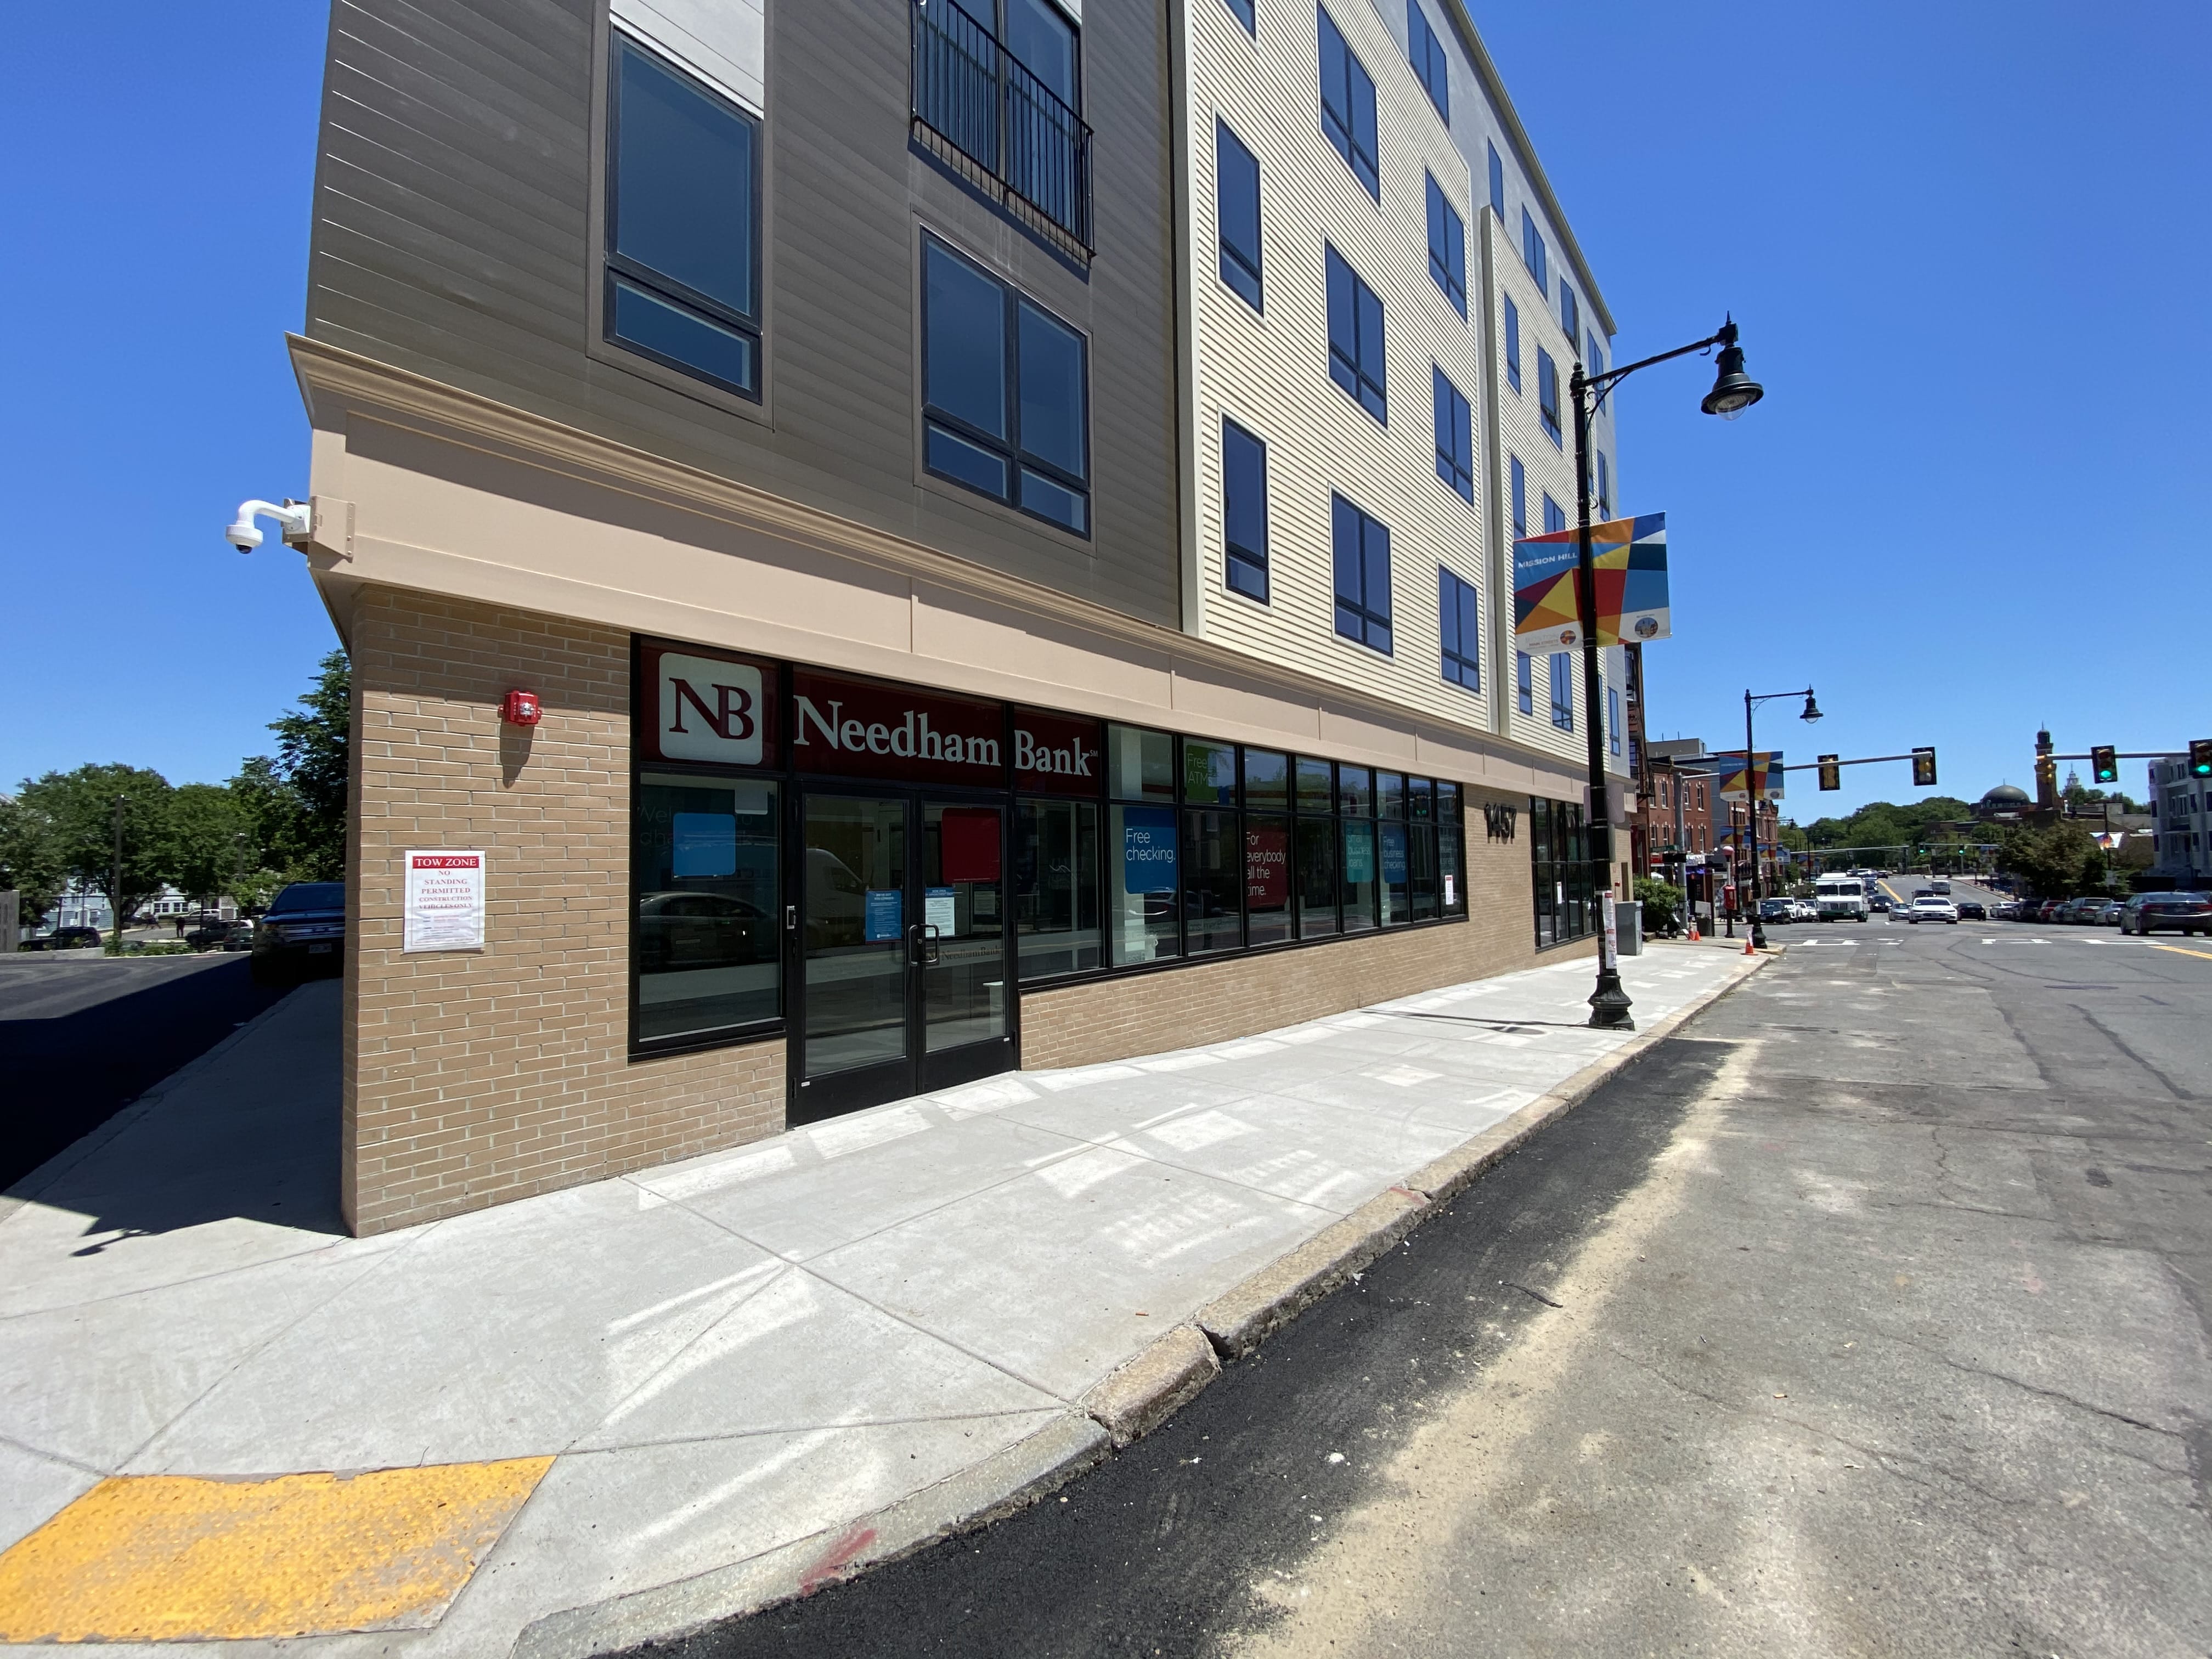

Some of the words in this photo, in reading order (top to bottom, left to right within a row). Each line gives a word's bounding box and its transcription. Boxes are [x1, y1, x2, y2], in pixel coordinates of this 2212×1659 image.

[1518, 555, 1555, 568] MISSION
[1558, 552, 1578, 561] HILL
[668, 677, 754, 740] NB
[793, 694, 1002, 766] Needham
[1014, 730, 1092, 777] Bank
[1187, 753, 1207, 768] Free
[1483, 803, 1517, 839] 1457
[1126, 828, 1150, 843] Free
[1126, 845, 1176, 863] checking.
[1246, 848, 1286, 865] everybody
[1348, 844, 1371, 855] business
[415, 858, 443, 866] TOW
[445, 858, 477, 866] ZONE
[1348, 856, 1363, 867] loans
[1256, 865, 1270, 879] the
